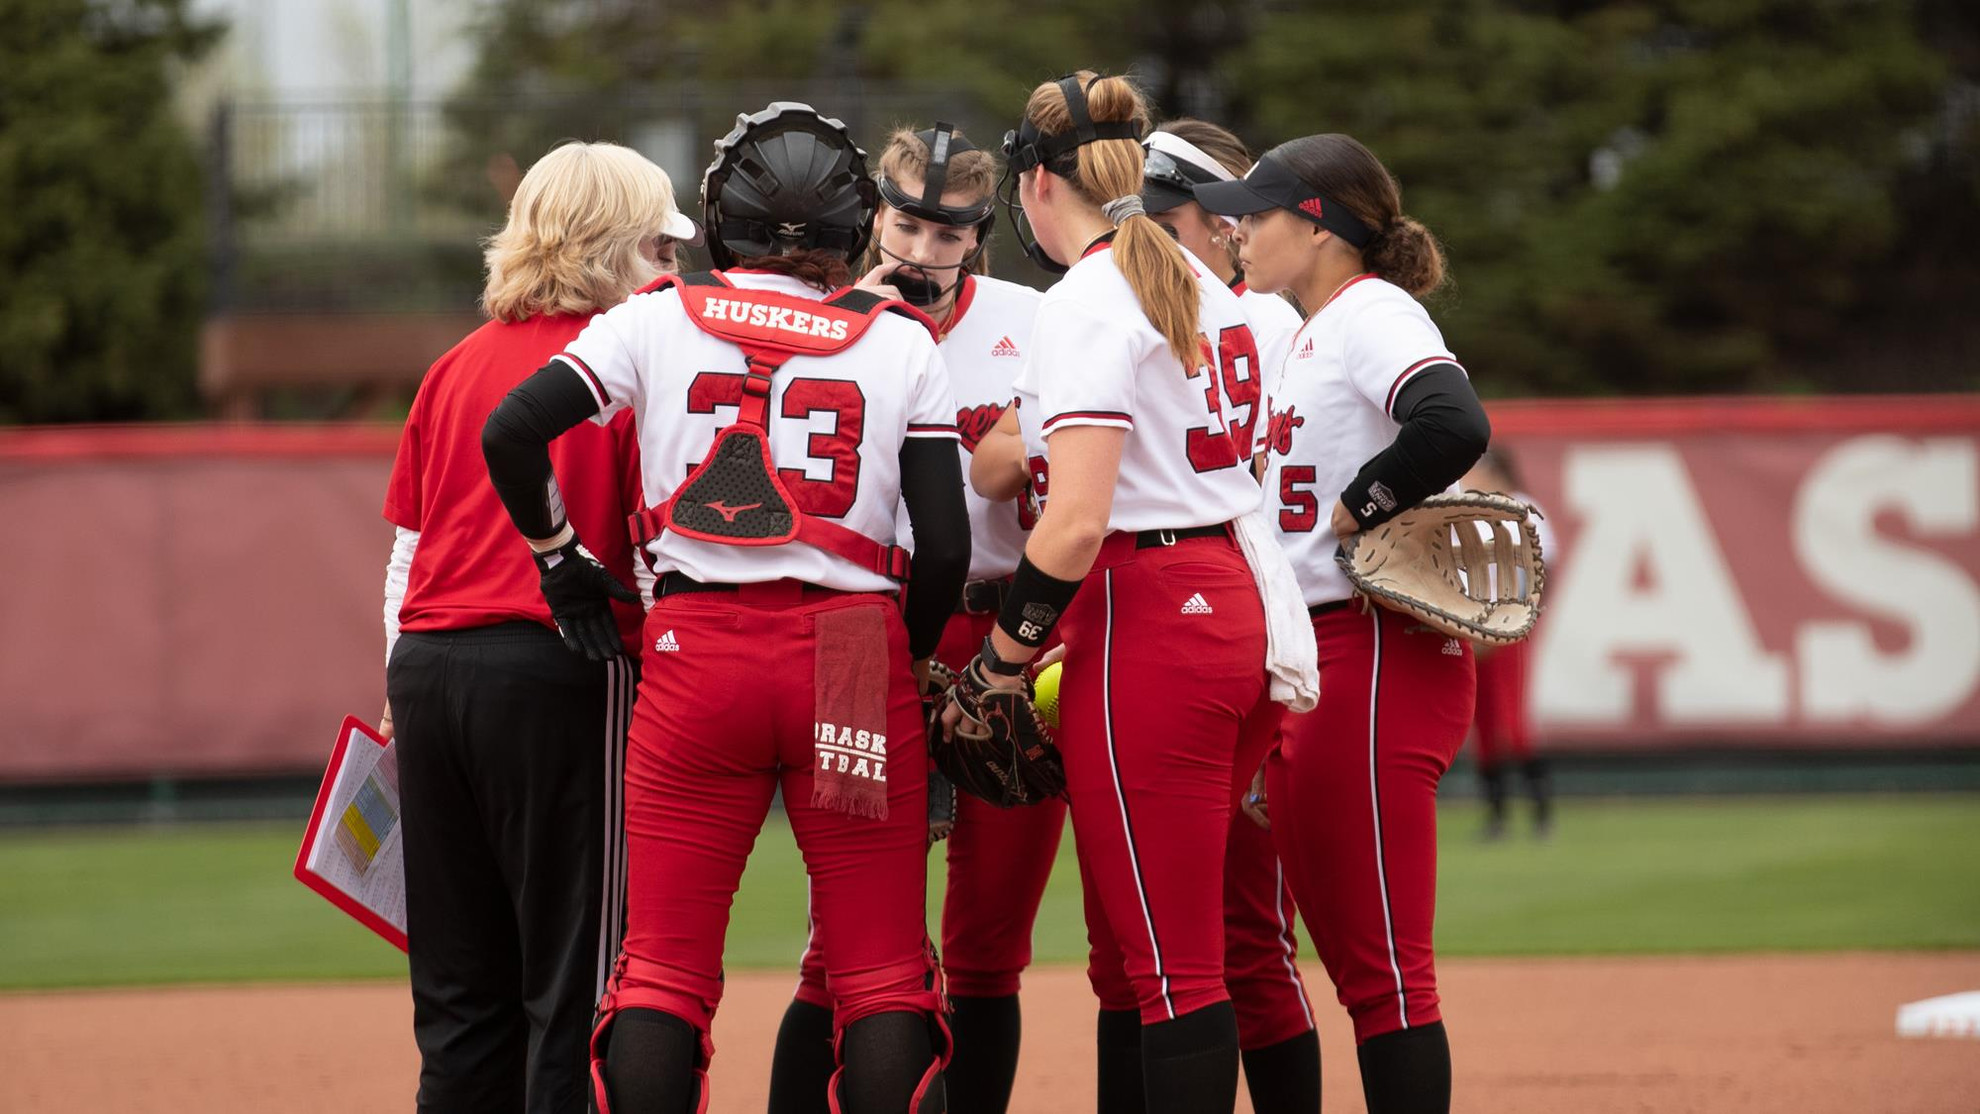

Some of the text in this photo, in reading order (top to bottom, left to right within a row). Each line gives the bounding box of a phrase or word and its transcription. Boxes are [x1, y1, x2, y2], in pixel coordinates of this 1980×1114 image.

[703, 297, 848, 340] HUSKERS
[1186, 323, 1262, 474] 39
[1279, 465, 1318, 533] 5
[1181, 604, 1213, 614] adidas
[655, 642, 680, 652] adidas
[815, 722, 886, 755] RASK
[820, 751, 886, 782] TBAL
